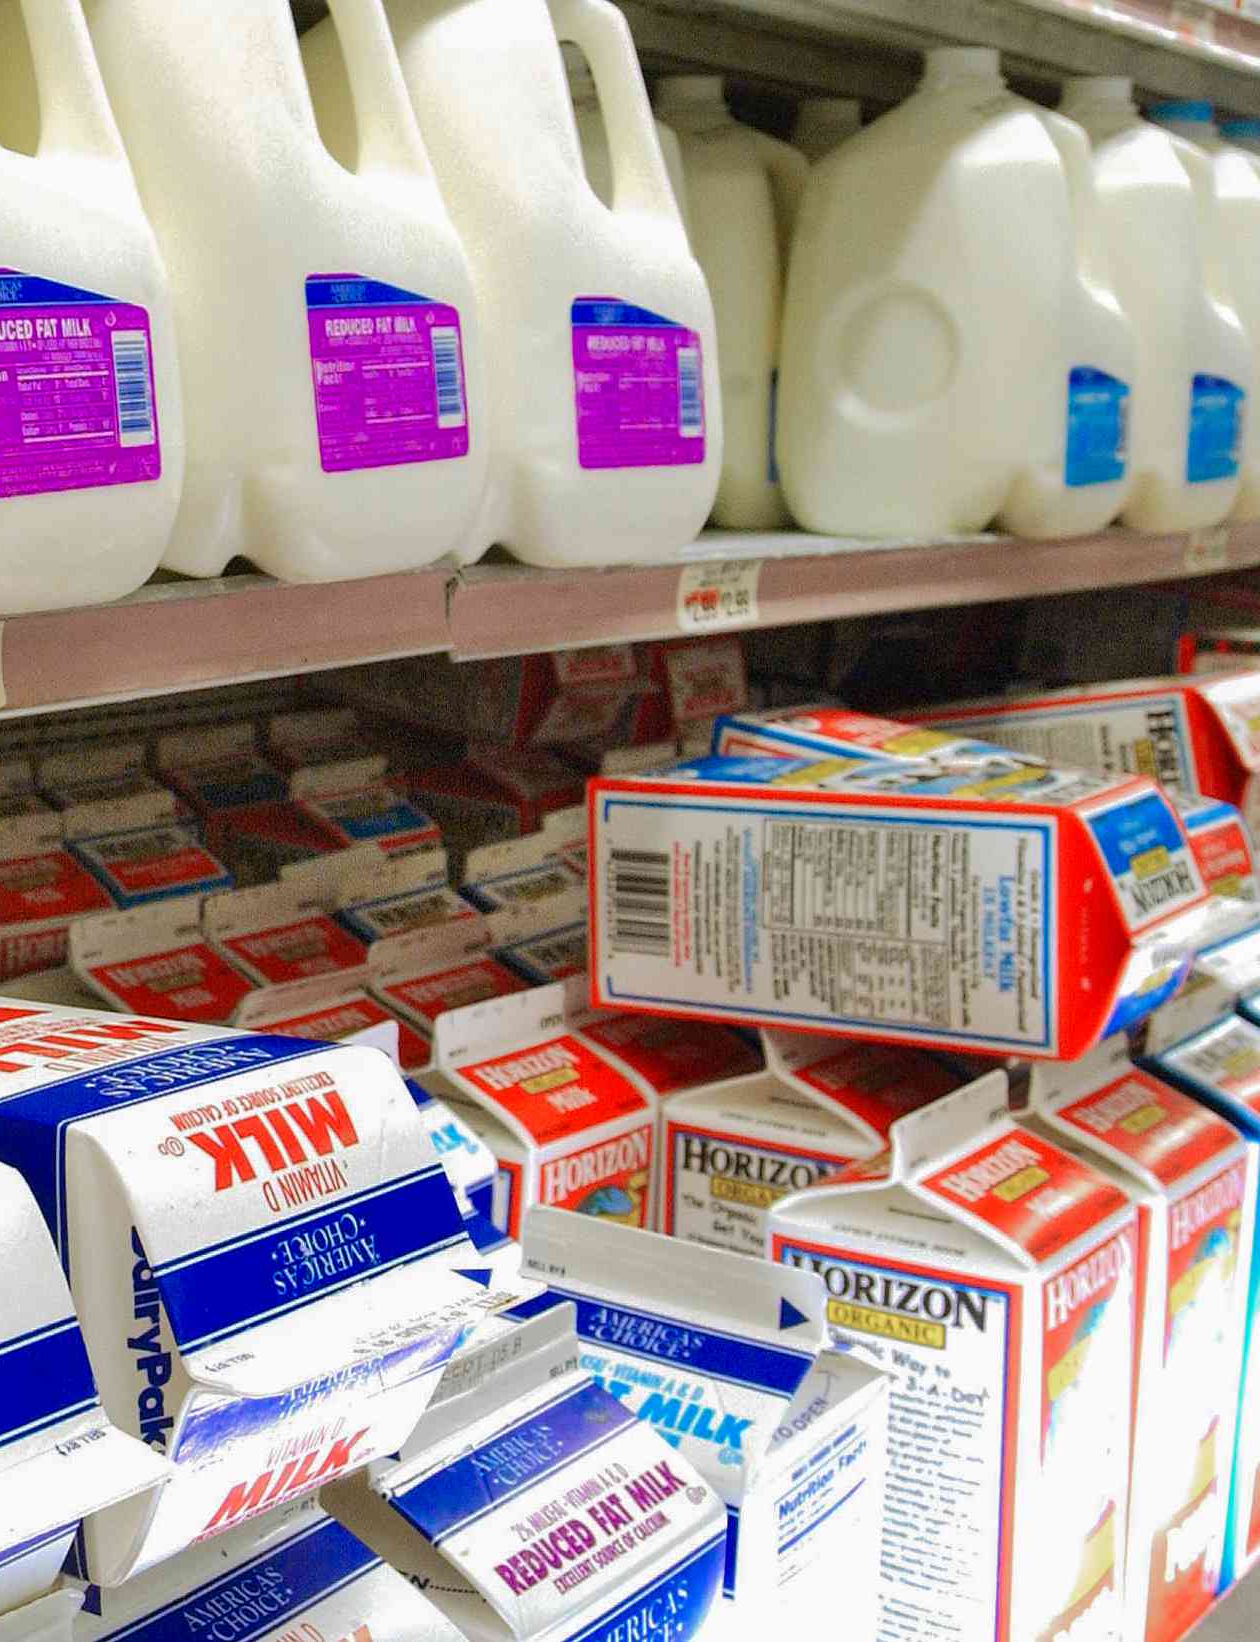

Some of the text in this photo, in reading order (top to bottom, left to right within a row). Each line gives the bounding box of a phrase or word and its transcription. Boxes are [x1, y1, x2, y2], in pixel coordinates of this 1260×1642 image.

[35, 319, 58, 339] FAT
[61, 317, 93, 338] MILK
[325, 316, 417, 338] REDUCED FAT MILK
[997, 875, 1016, 993] Lowfat Milk
[73, 1036, 178, 1065] VITAMIN
[473, 1041, 582, 1090] HORIZON
[168, 1071, 336, 1132] EXCELLENT SOURCE OF CALCIUM
[189, 1090, 360, 1193] MILK
[543, 1127, 653, 1206] HORIZON
[262, 1161, 349, 1214] VITAMIN D
[940, 1135, 1043, 1203] HORIZON
[278, 1212, 359, 1264] CHOICE
[595, 1323, 685, 1359] CHOICE
[833, 1303, 938, 1344] ORGANIC
[612, 1363, 662, 1388] VITAMIN
[662, 1379, 672, 1394] A
[891, 1348, 951, 1379] Way to
[636, 1391, 754, 1450] MILK
[792, 1396, 829, 1432] OPEN
[201, 1425, 372, 1533] MILK
[494, 1441, 559, 1488] CHOICE
[525, 1472, 614, 1533] MILKFAT VITAMIN A
[777, 1469, 834, 1520] Nutrition
[494, 1460, 688, 1597] REDUCED FAT MILK
[552, 1510, 671, 1596] EXCELLENT SOURCE OF CALCIUM
[210, 1588, 290, 1642] CHOICE
